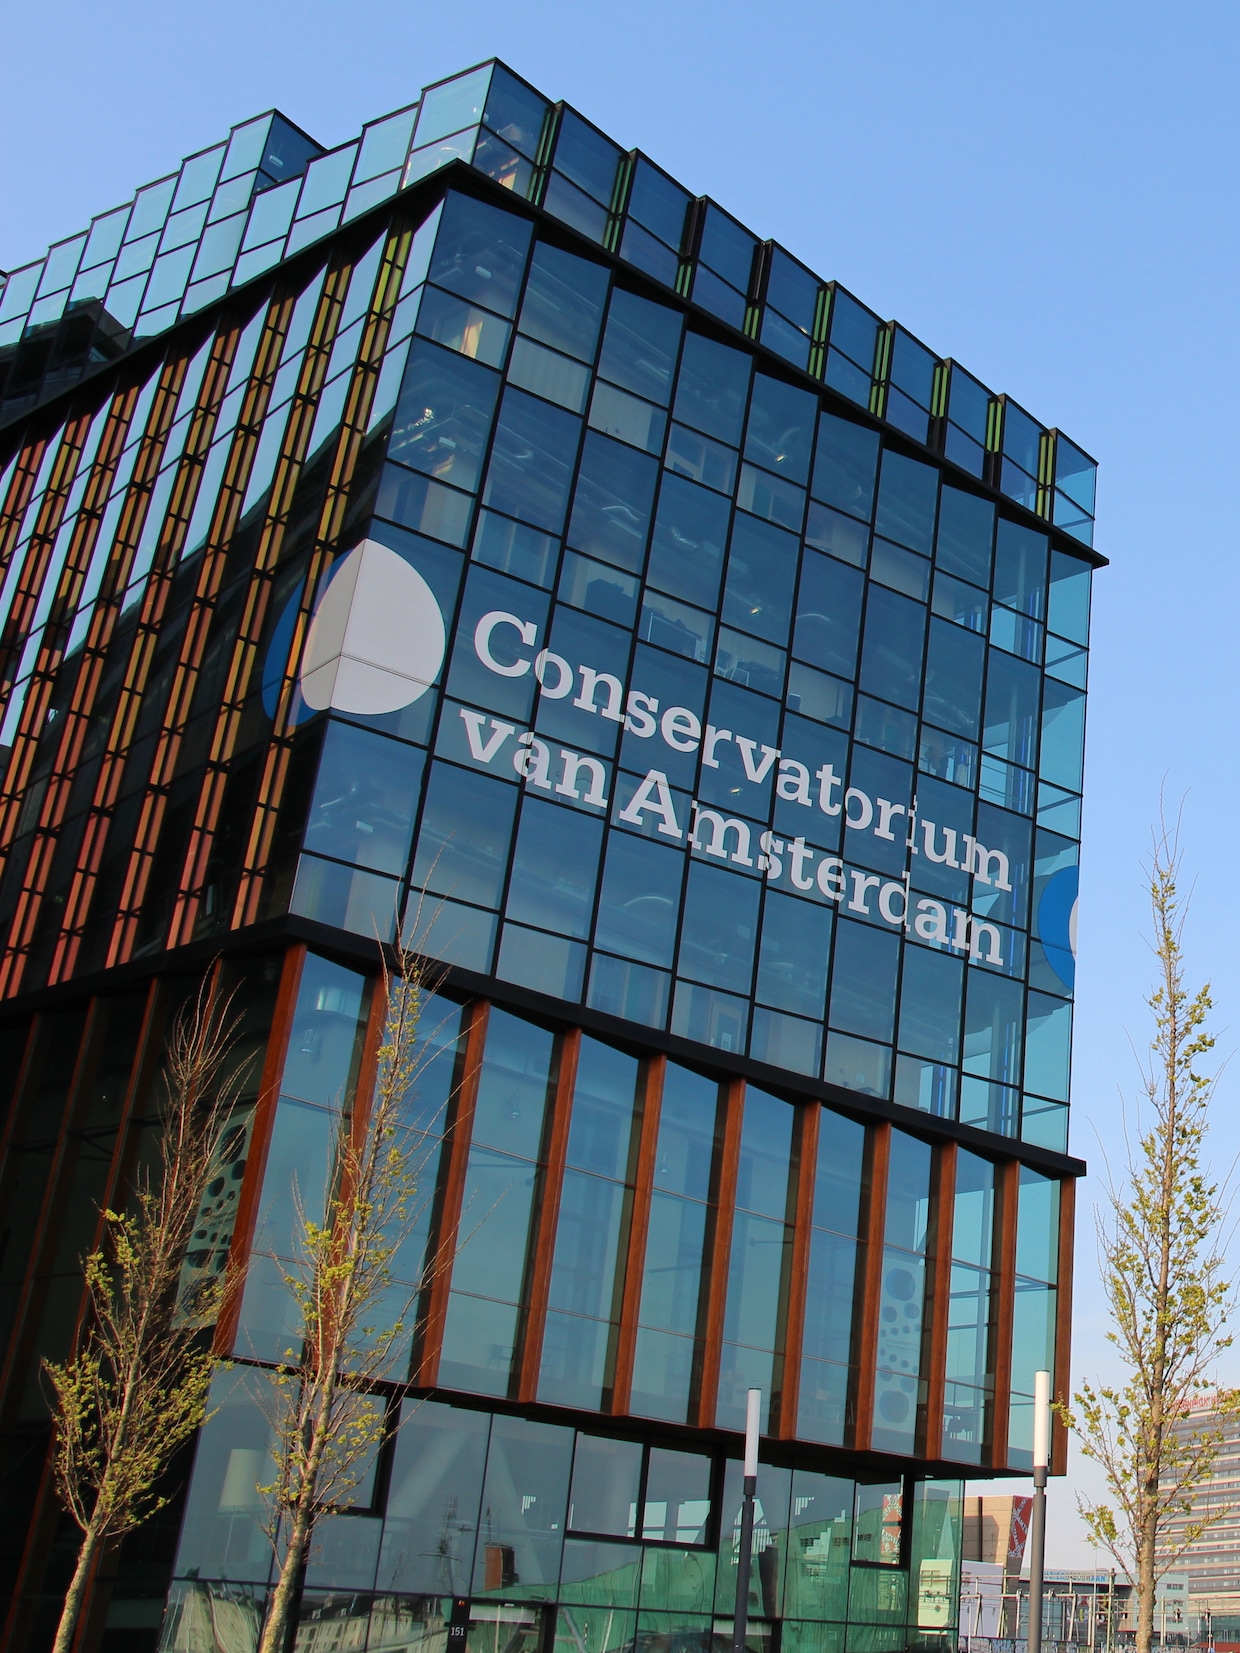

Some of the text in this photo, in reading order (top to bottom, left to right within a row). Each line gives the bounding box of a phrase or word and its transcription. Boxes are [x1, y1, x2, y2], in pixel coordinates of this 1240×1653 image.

[459, 708, 1005, 967] van Amsterdam
[474, 610, 1012, 893] Conservatorium
[450, 1626, 465, 1637] 151
